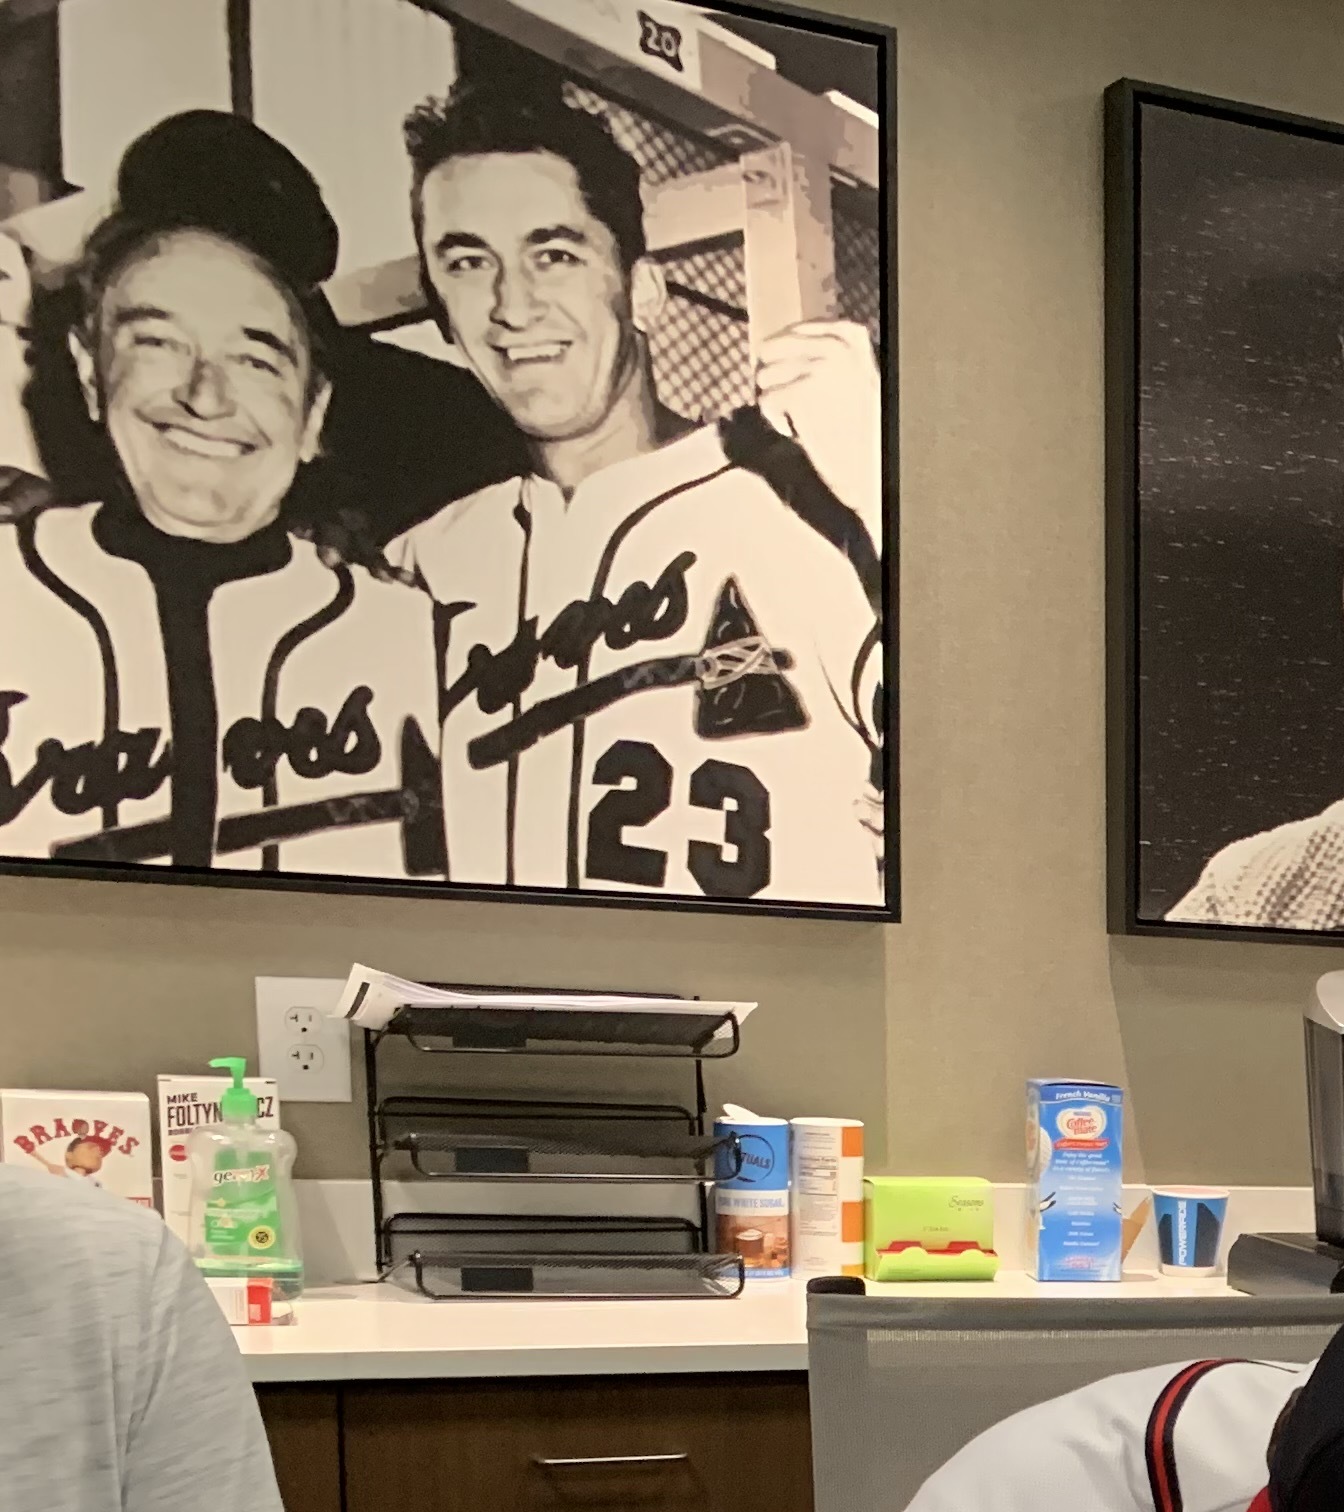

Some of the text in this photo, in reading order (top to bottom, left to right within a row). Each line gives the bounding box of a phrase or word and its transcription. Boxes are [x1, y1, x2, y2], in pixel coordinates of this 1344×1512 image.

[644, 20, 677, 57] 20
[432, 550, 698, 728] raves
[586, 739, 772, 899] 23
[166, 1092, 198, 1105] MIKE
[167, 1096, 274, 1128] FOLTYNCZ
[740, 1151, 772, 1170] TUALS
